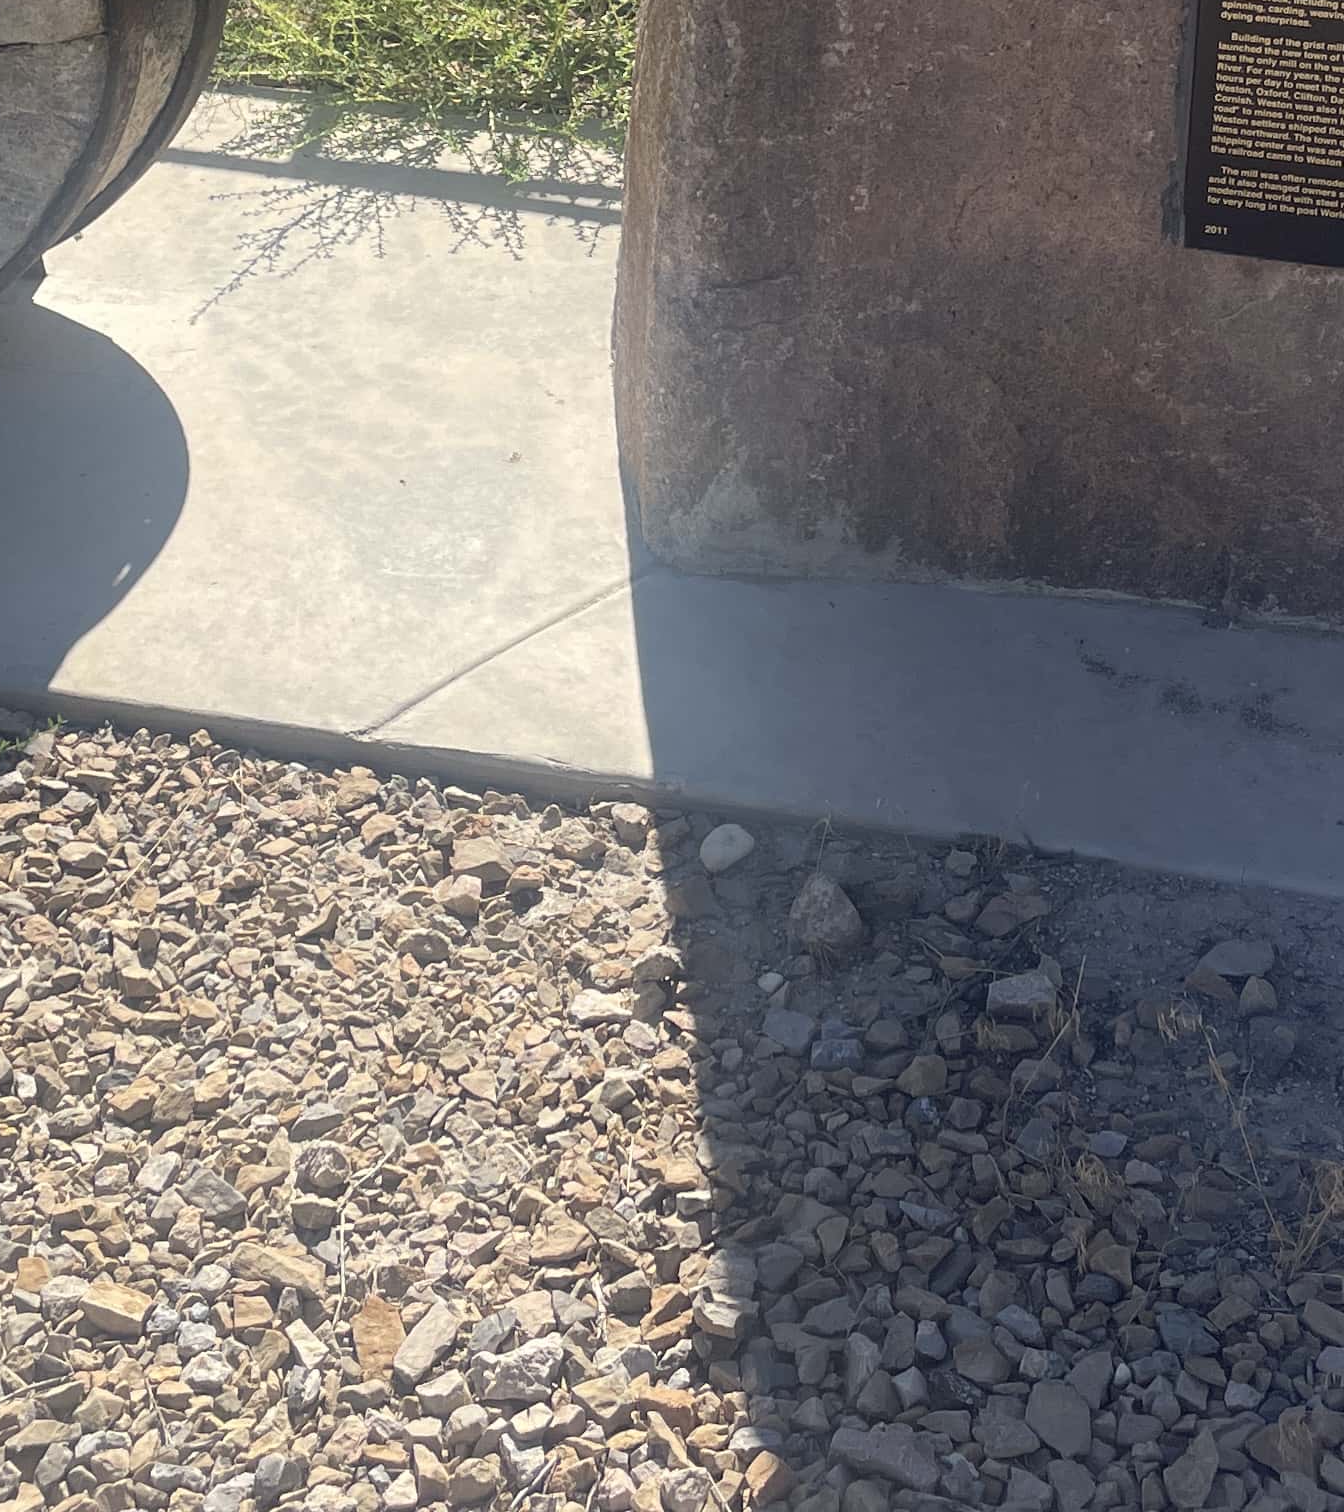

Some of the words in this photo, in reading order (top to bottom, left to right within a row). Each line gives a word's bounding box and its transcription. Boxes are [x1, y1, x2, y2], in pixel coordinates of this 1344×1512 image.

[1218, 41, 1262, 53] launched
[1264, 46, 1280, 55] the
[1281, 49, 1302, 57] new
[1303, 50, 1327, 60] town
[1329, 52, 1340, 61] of
[1213, 113, 1248, 125] Weston
[1250, 117, 1286, 129] settlers
[1288, 122, 1326, 135] shipped
[1204, 224, 1227, 235] 2011
